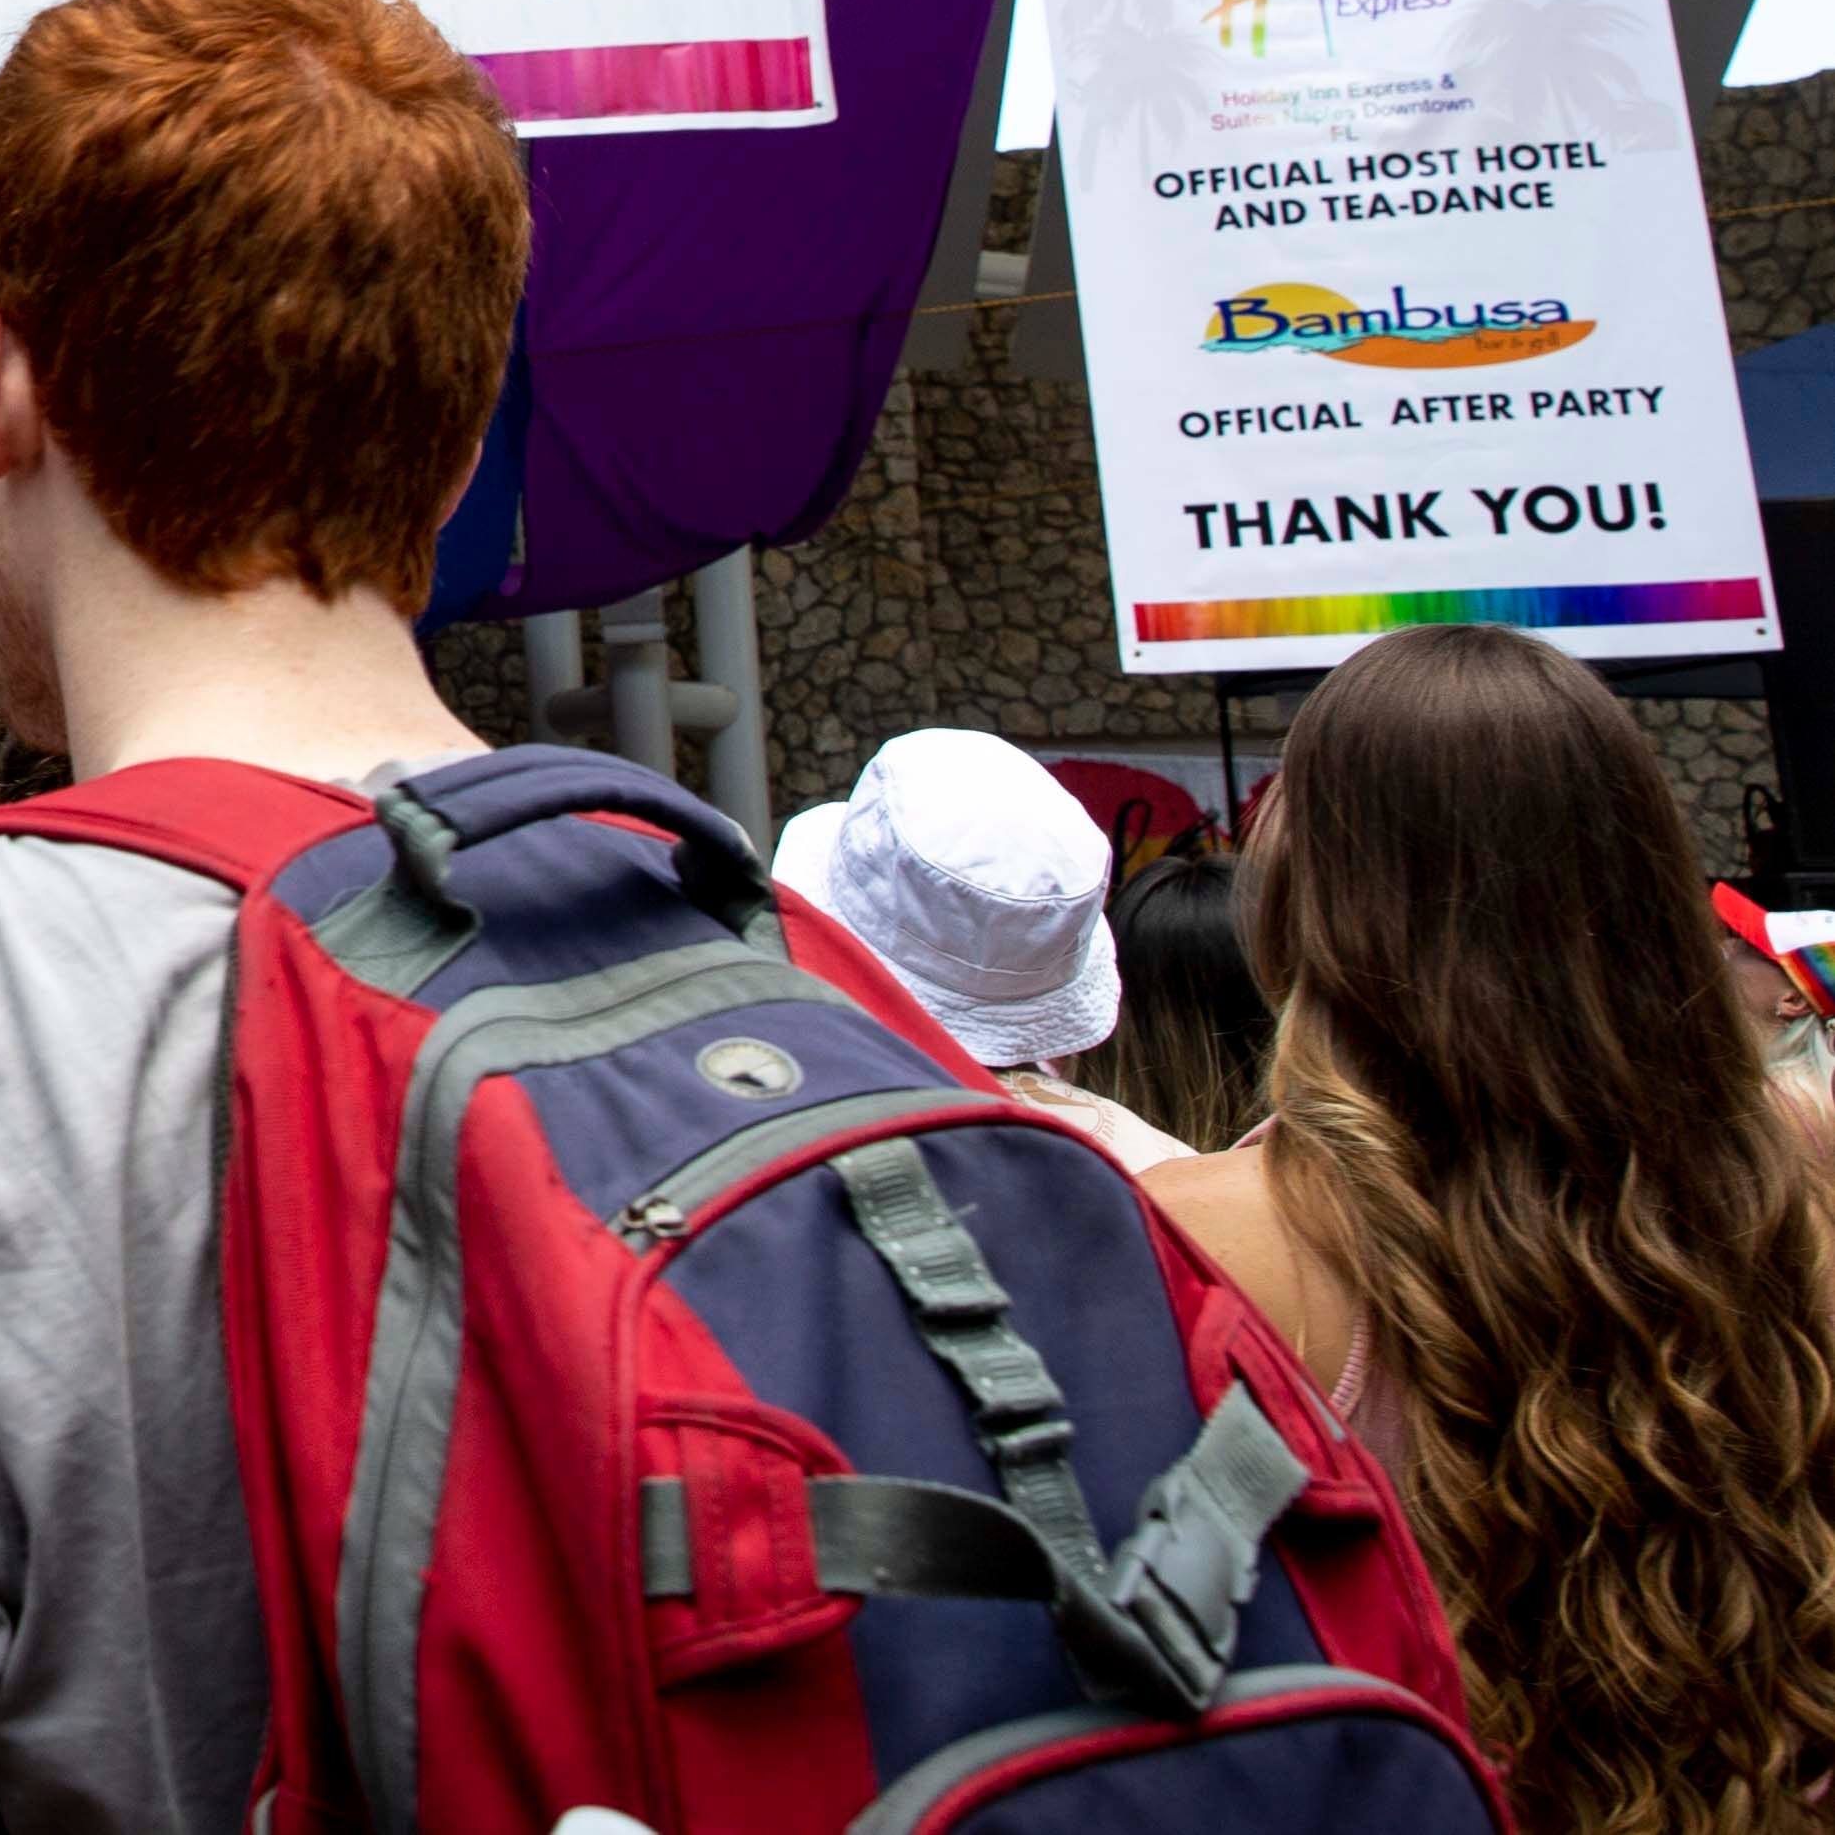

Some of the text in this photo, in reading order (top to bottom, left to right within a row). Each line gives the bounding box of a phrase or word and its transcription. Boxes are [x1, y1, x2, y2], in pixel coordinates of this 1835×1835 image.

[1347, 76, 1433, 102] Express
[1154, 141, 1607, 199] OFFICIAL HOST HOTEL
[1214, 181, 1555, 231] AND TEA-DANCE
[1213, 285, 1571, 344] Bambusa
[1178, 386, 1664, 439] OFFICIAL AFTER PARTY
[1183, 482, 1667, 549] THANK YOU!
